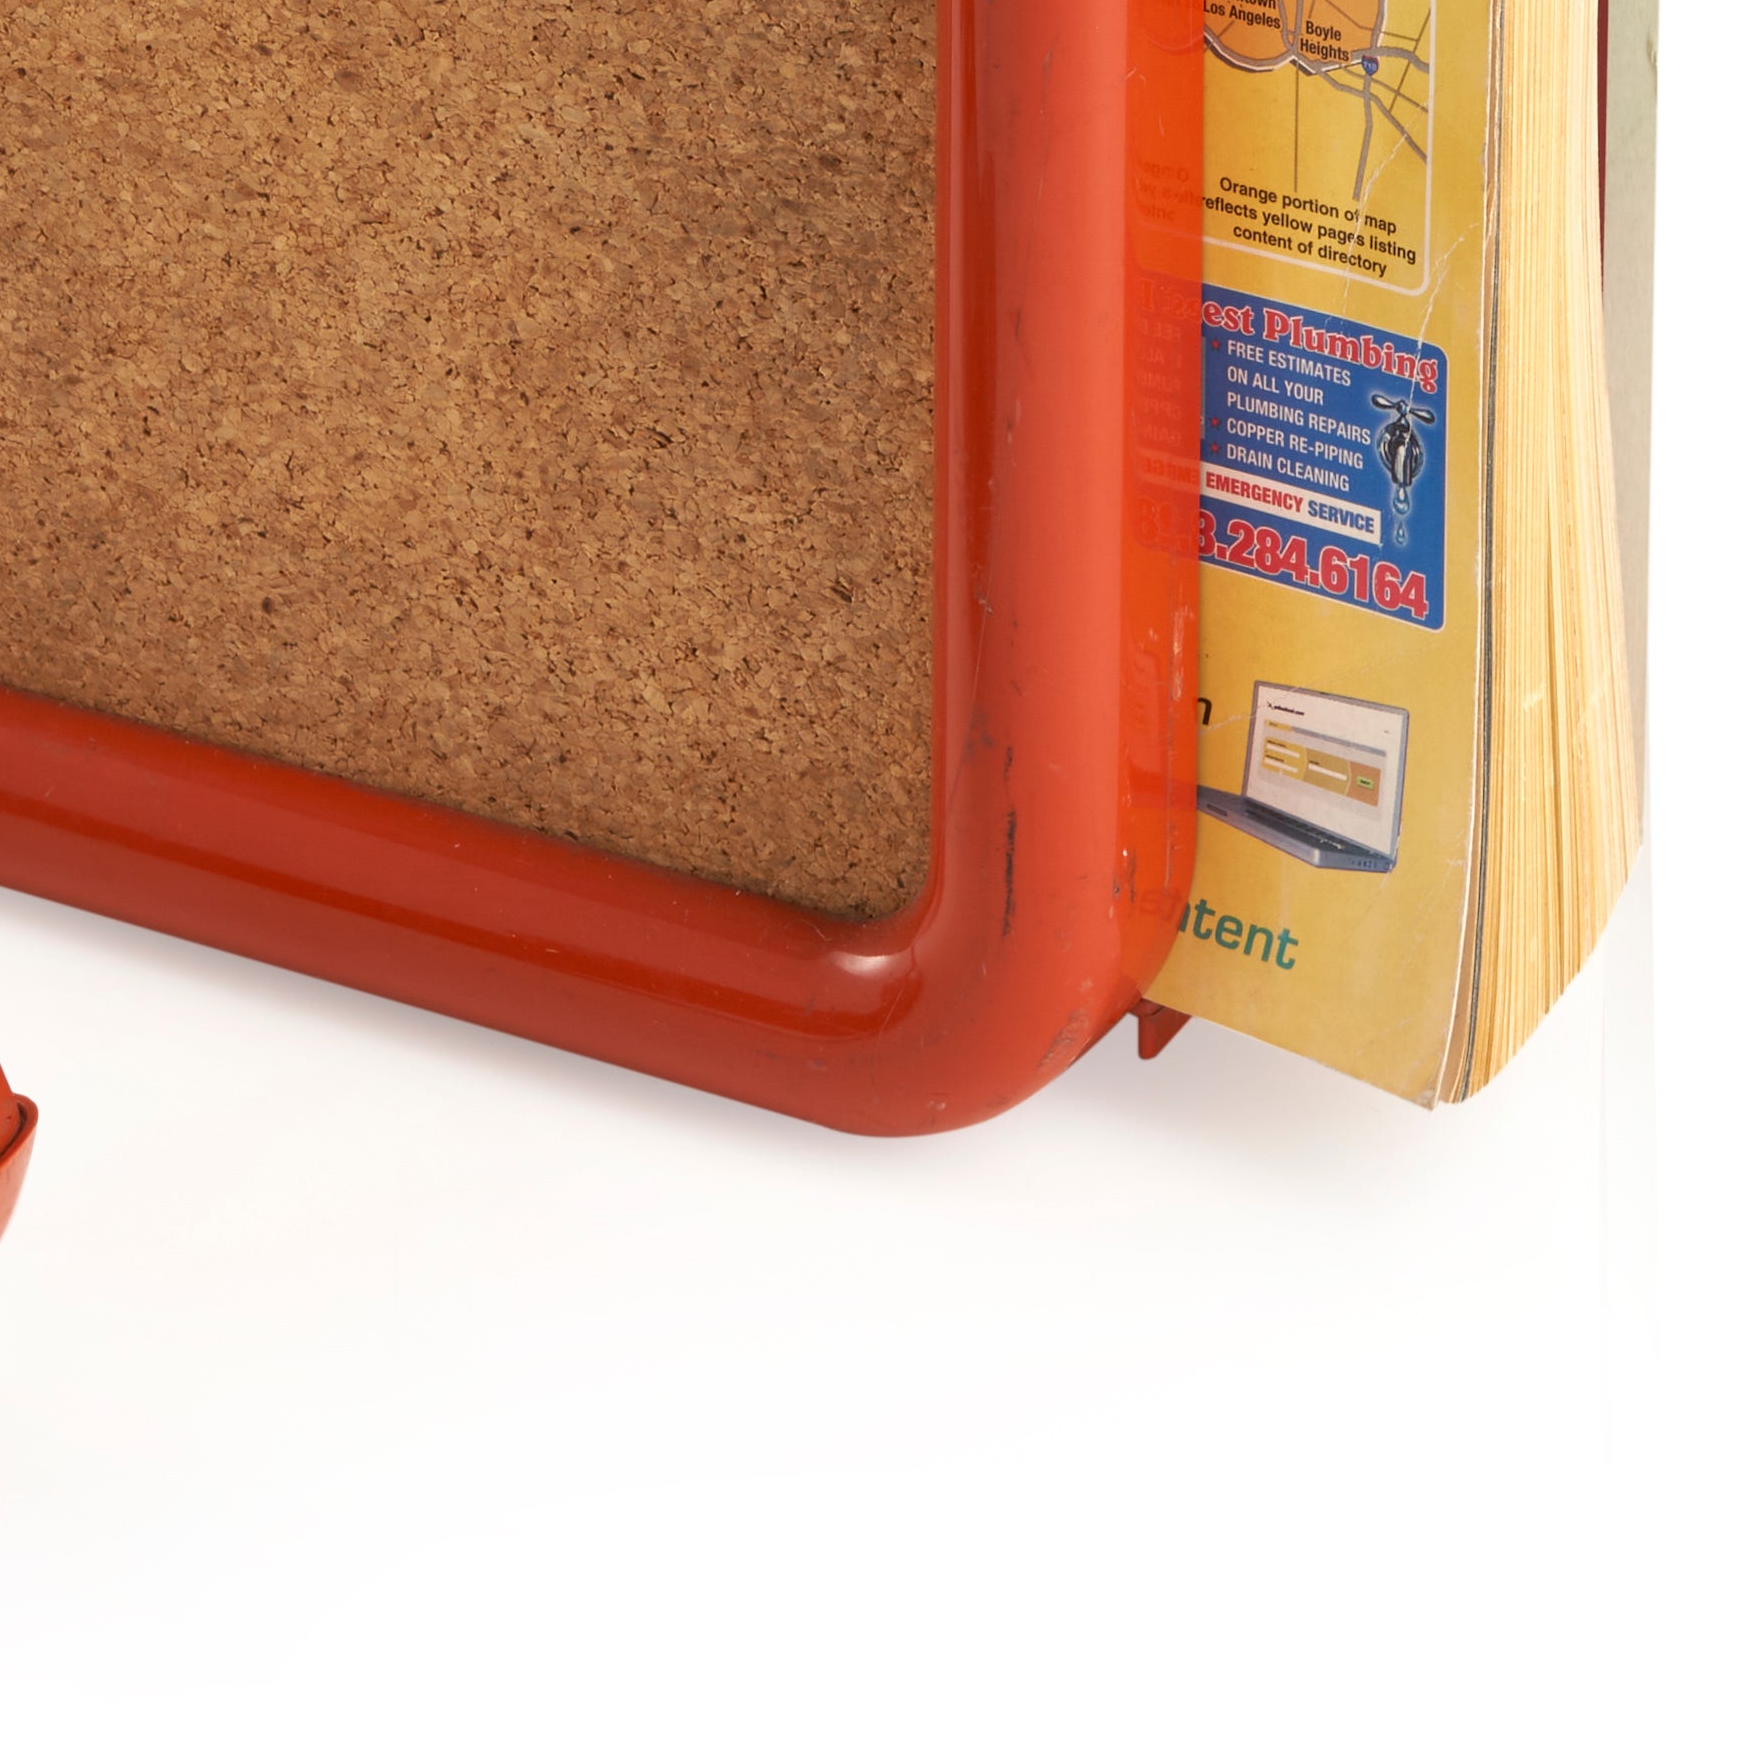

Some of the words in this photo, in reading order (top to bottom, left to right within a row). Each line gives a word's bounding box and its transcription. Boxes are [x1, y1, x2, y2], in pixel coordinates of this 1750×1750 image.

[1204, 0, 1226, 16] Los
[1229, 5, 1281, 30] Angeles
[1306, 20, 1342, 42] Boyle
[1300, 38, 1349, 62] Heights
[1219, 177, 1277, 203] Orange
[1282, 195, 1339, 219] portion
[1365, 213, 1397, 235] map
[1233, 226, 1293, 251] content
[1300, 241, 1313, 255] of
[1318, 245, 1387, 278] directory
[1262, 210, 1313, 233] yellow
[1318, 224, 1365, 247] pages
[1370, 235, 1416, 265] listing
[1202, 302, 1254, 335] est
[1263, 308, 1438, 393] Plumbing
[1228, 340, 1264, 363] FREE
[1268, 350, 1351, 387] ESTIMATES
[1227, 366, 1248, 385] ON
[1252, 372, 1280, 394] ALL
[1285, 381, 1324, 405] YOUR
[1227, 391, 1304, 427] PLUMBING
[1308, 413, 1371, 446] REPAIRS
[1227, 418, 1285, 447] COPPER
[1289, 437, 1363, 470] RE-PIPING
[1227, 444, 1273, 468] DRAIN
[1277, 457, 1349, 492] CLEANING
[1206, 471, 1303, 513] EMERGENCY
[1308, 500, 1375, 534] SERVICE
